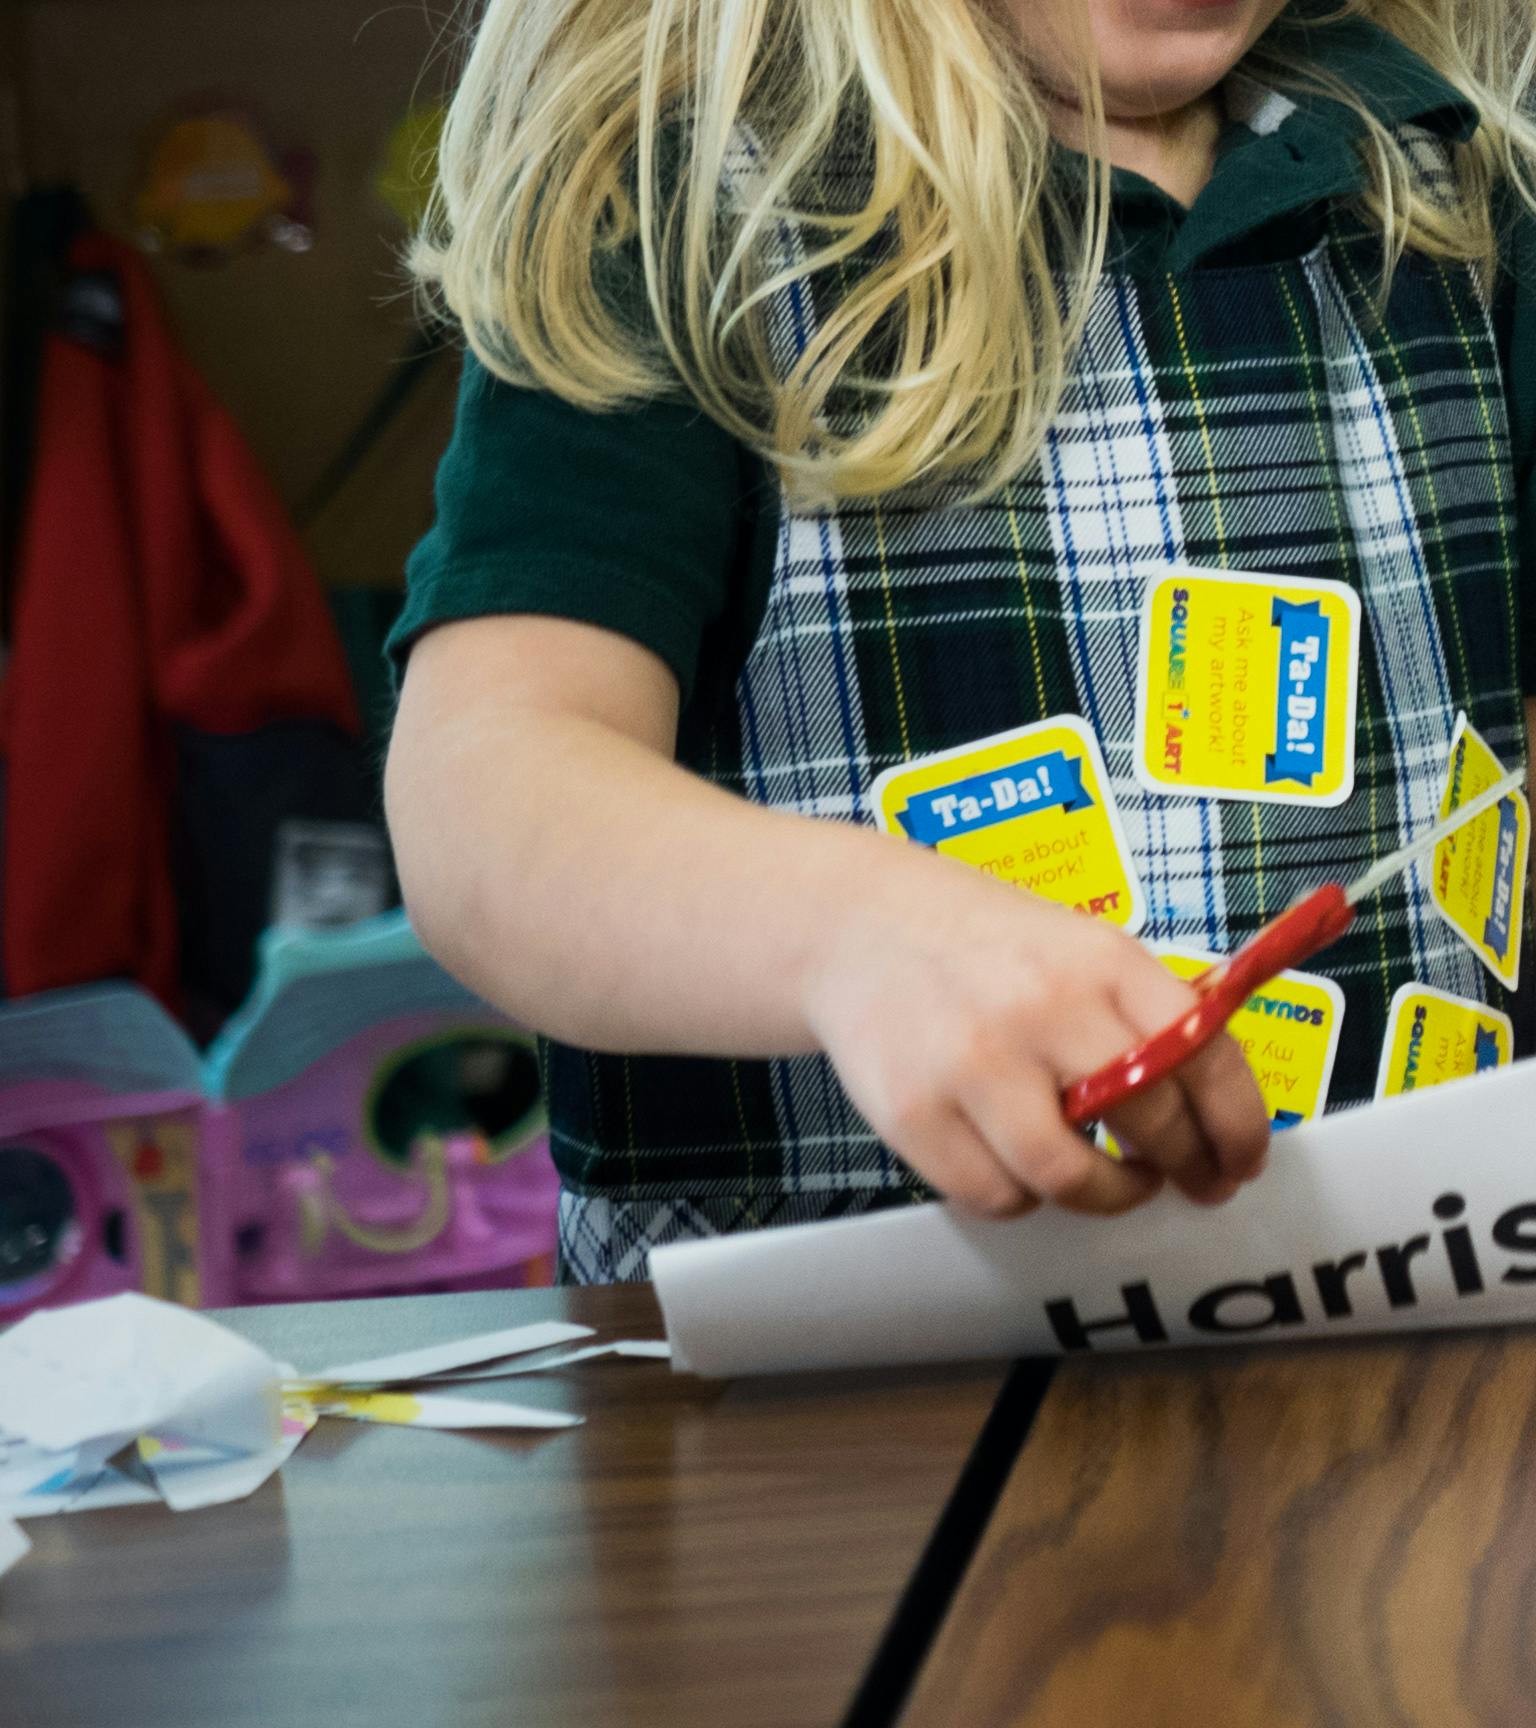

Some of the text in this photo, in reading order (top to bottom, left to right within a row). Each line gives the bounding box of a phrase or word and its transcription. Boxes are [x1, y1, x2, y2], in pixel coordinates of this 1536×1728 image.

[1167, 587, 1190, 690] SQUARE
[1208, 616, 1227, 754] my artwork!
[1232, 607, 1255, 767] Ask me about
[1286, 635, 1321, 755] Ta-Da!
[1164, 722, 1184, 775] ART
[930, 765, 1054, 828] Ta-Da!
[979, 829, 1089, 876] me about
[1011, 855, 1086, 890] twork!
[1494, 829, 1515, 936] Ta-Da!
[1260, 1068, 1299, 1093] Ask
[1262, 1039, 1295, 1062] my
